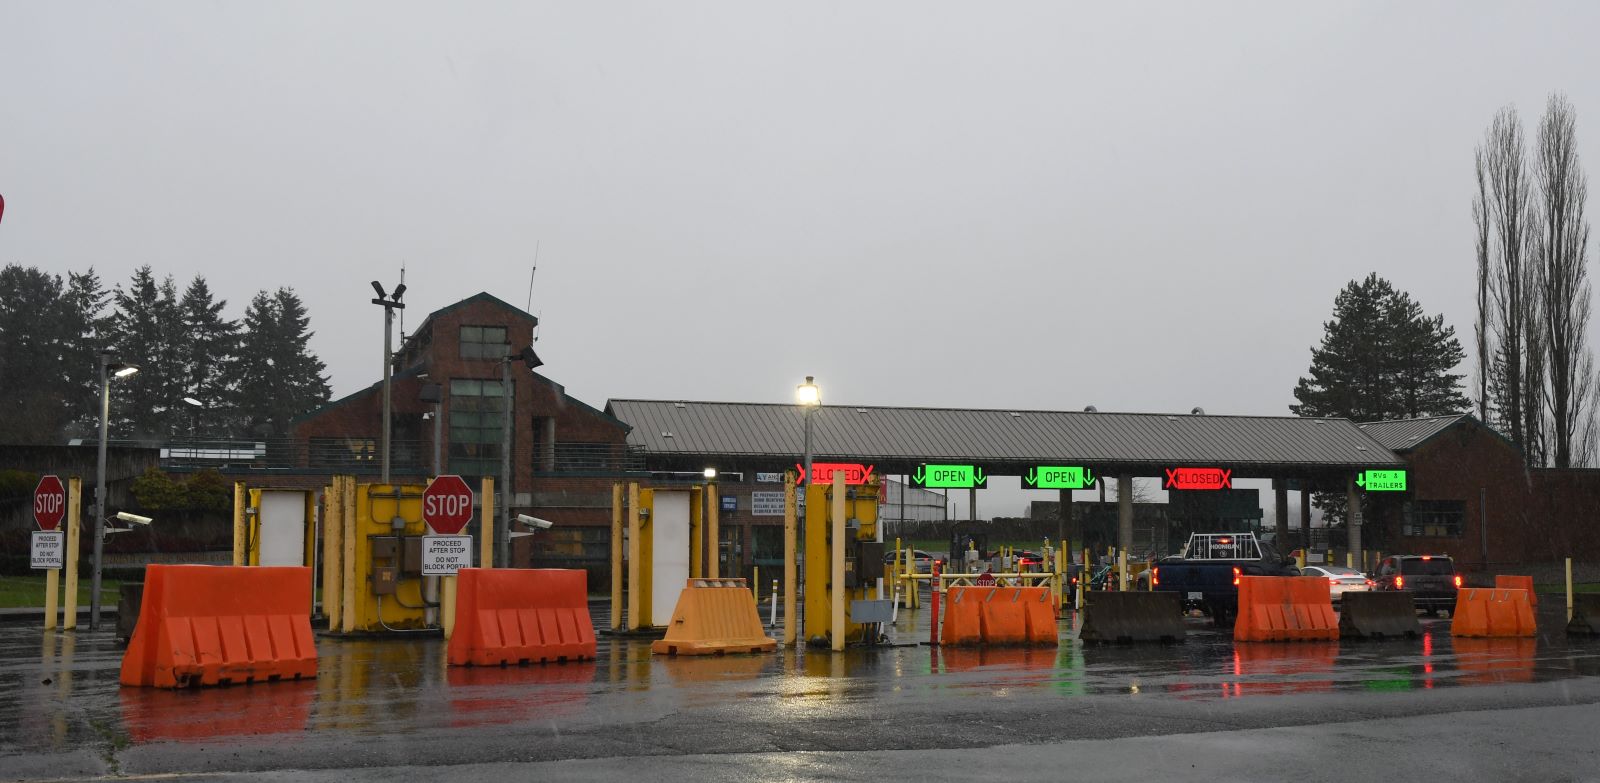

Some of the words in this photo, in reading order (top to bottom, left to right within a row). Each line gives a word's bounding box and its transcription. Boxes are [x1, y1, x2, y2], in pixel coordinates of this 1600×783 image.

[812, 469, 859, 481] CLOED
[934, 470, 966, 482] OPEN
[1045, 472, 1076, 483] OPEN
[1178, 473, 1220, 484] CLOSED
[36, 493, 63, 514] STOP
[426, 494, 470, 516] STOP
[977, 579, 995, 587] STOP
